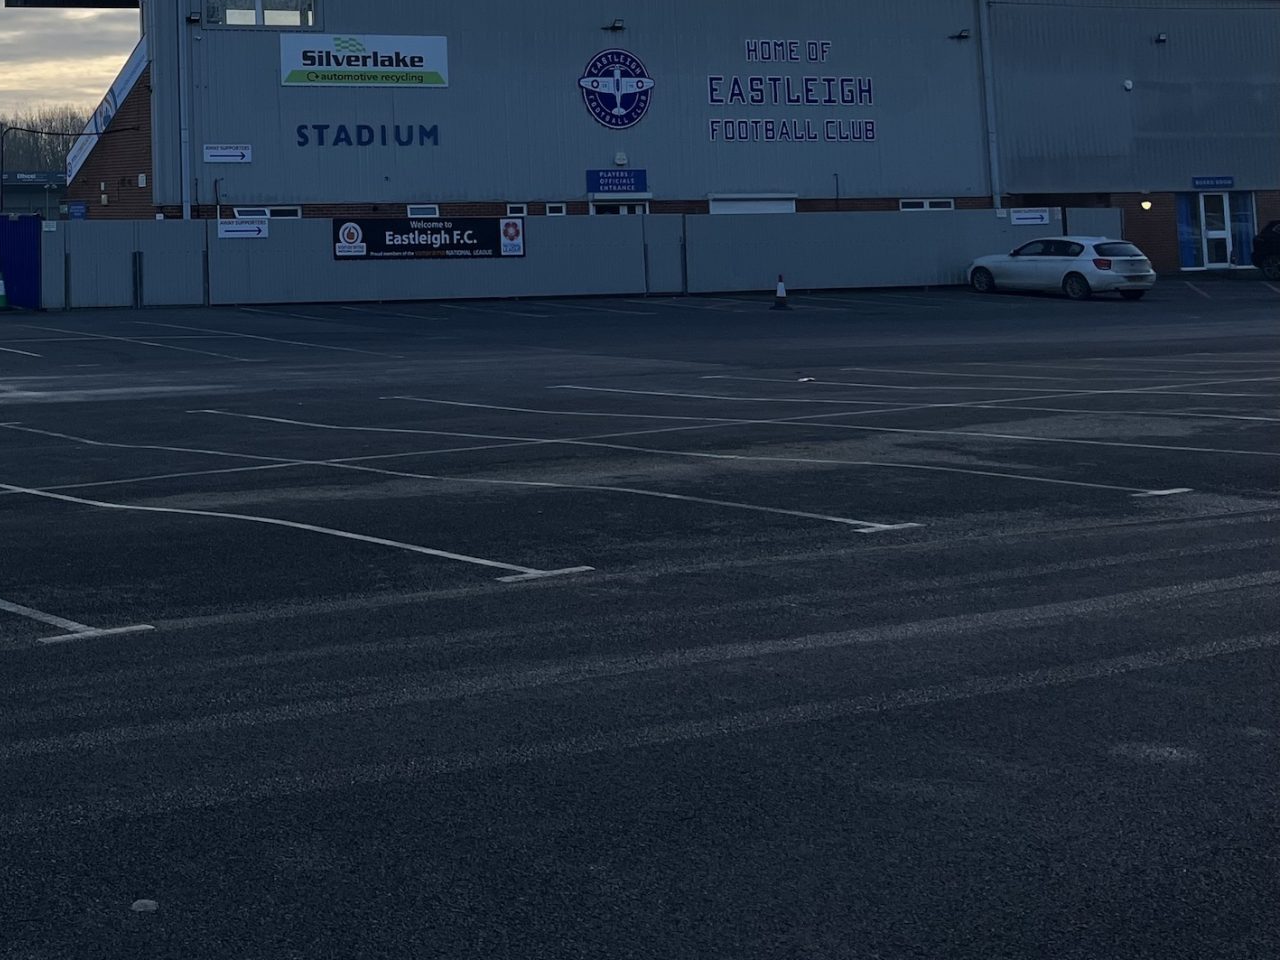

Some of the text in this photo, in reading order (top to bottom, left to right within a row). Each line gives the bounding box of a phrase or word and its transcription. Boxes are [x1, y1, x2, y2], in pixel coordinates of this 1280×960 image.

[302, 50, 424, 68] Silverlake
[745, 39, 832, 62] HOME OF
[591, 54, 642, 74] EASTLEIGH
[320, 72, 424, 83] automotive recycling
[708, 75, 873, 105] EASTLEIGH
[588, 94, 647, 125] FOOTBALL CLUB
[296, 124, 439, 147] STADIUM
[709, 118, 876, 141] FOOTBALL CLUB
[410, 221, 452, 229] Welcome to
[385, 230, 478, 248] Eastleigh F.C.
